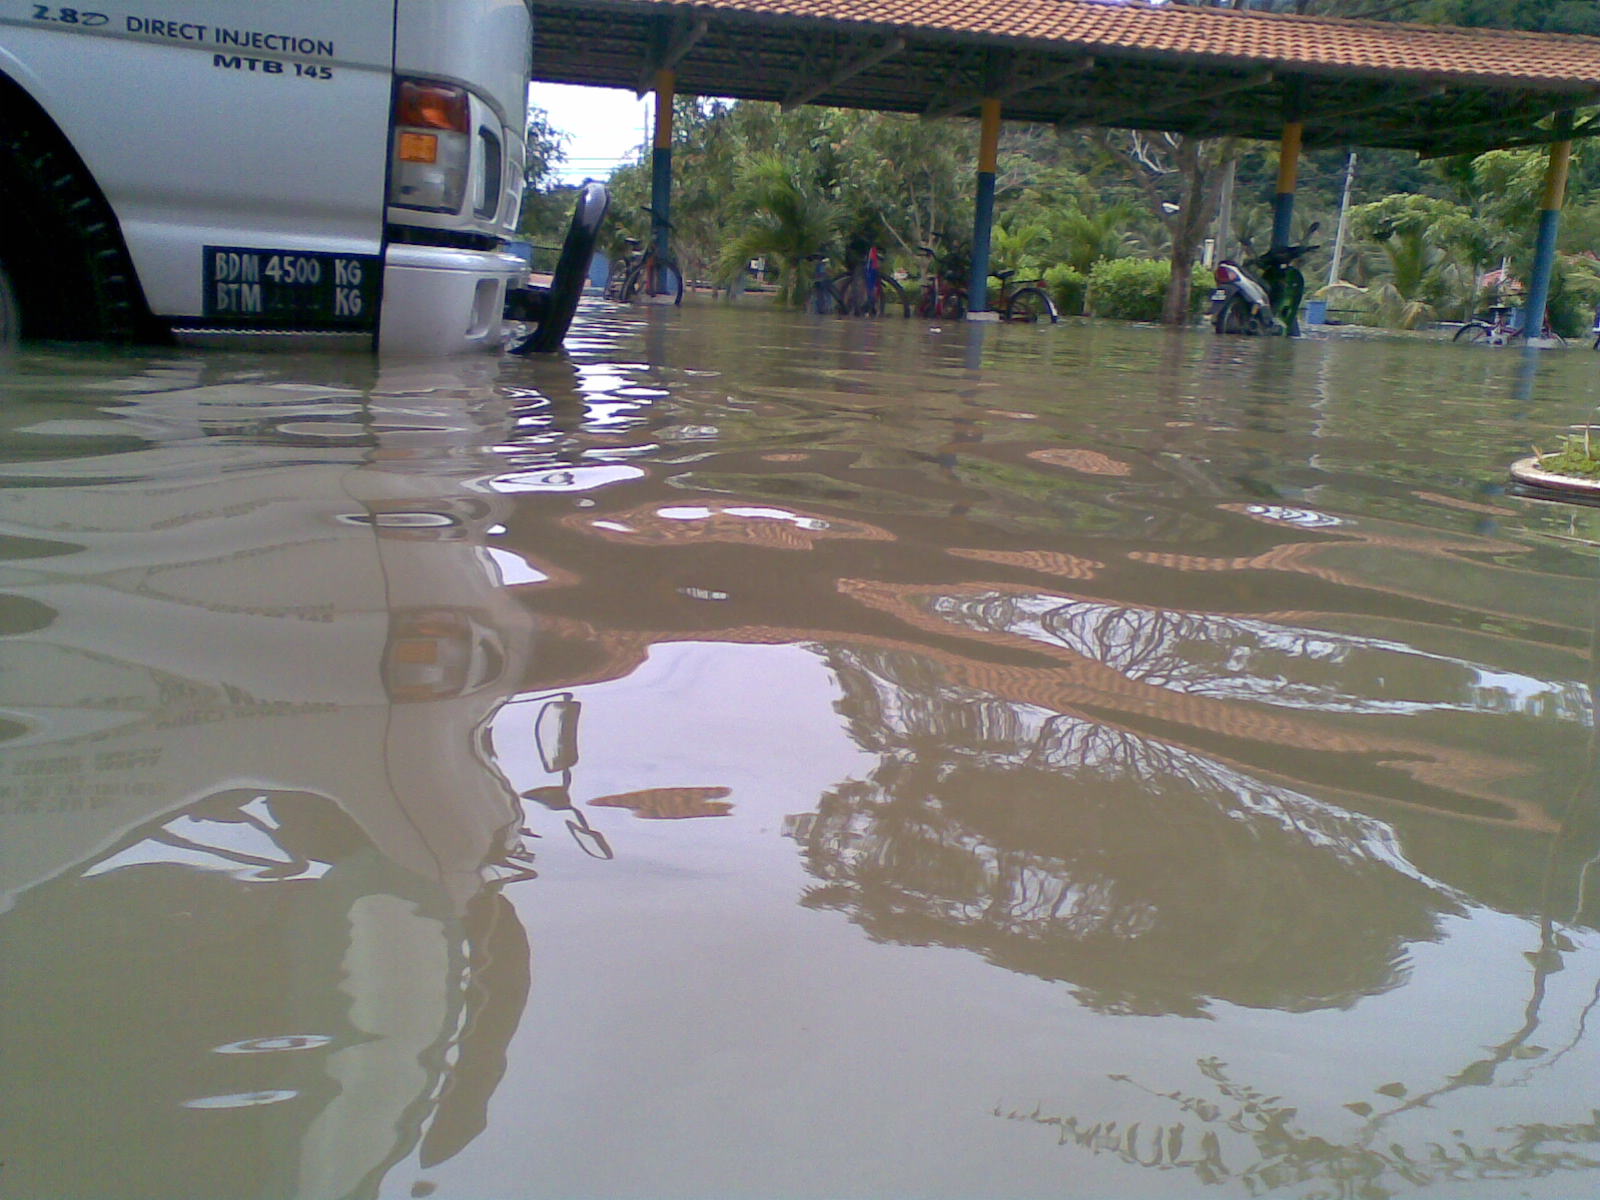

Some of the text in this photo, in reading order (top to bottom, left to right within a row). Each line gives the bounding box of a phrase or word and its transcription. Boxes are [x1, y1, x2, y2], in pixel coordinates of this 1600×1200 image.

[127, 16, 207, 41] DIRECT
[215, 28, 334, 56] INJECTION
[213, 54, 333, 80] MTB 145
[215, 252, 362, 285] BDM 4500 KG
[216, 283, 262, 312] BTM
[335, 287, 362, 316] KG
